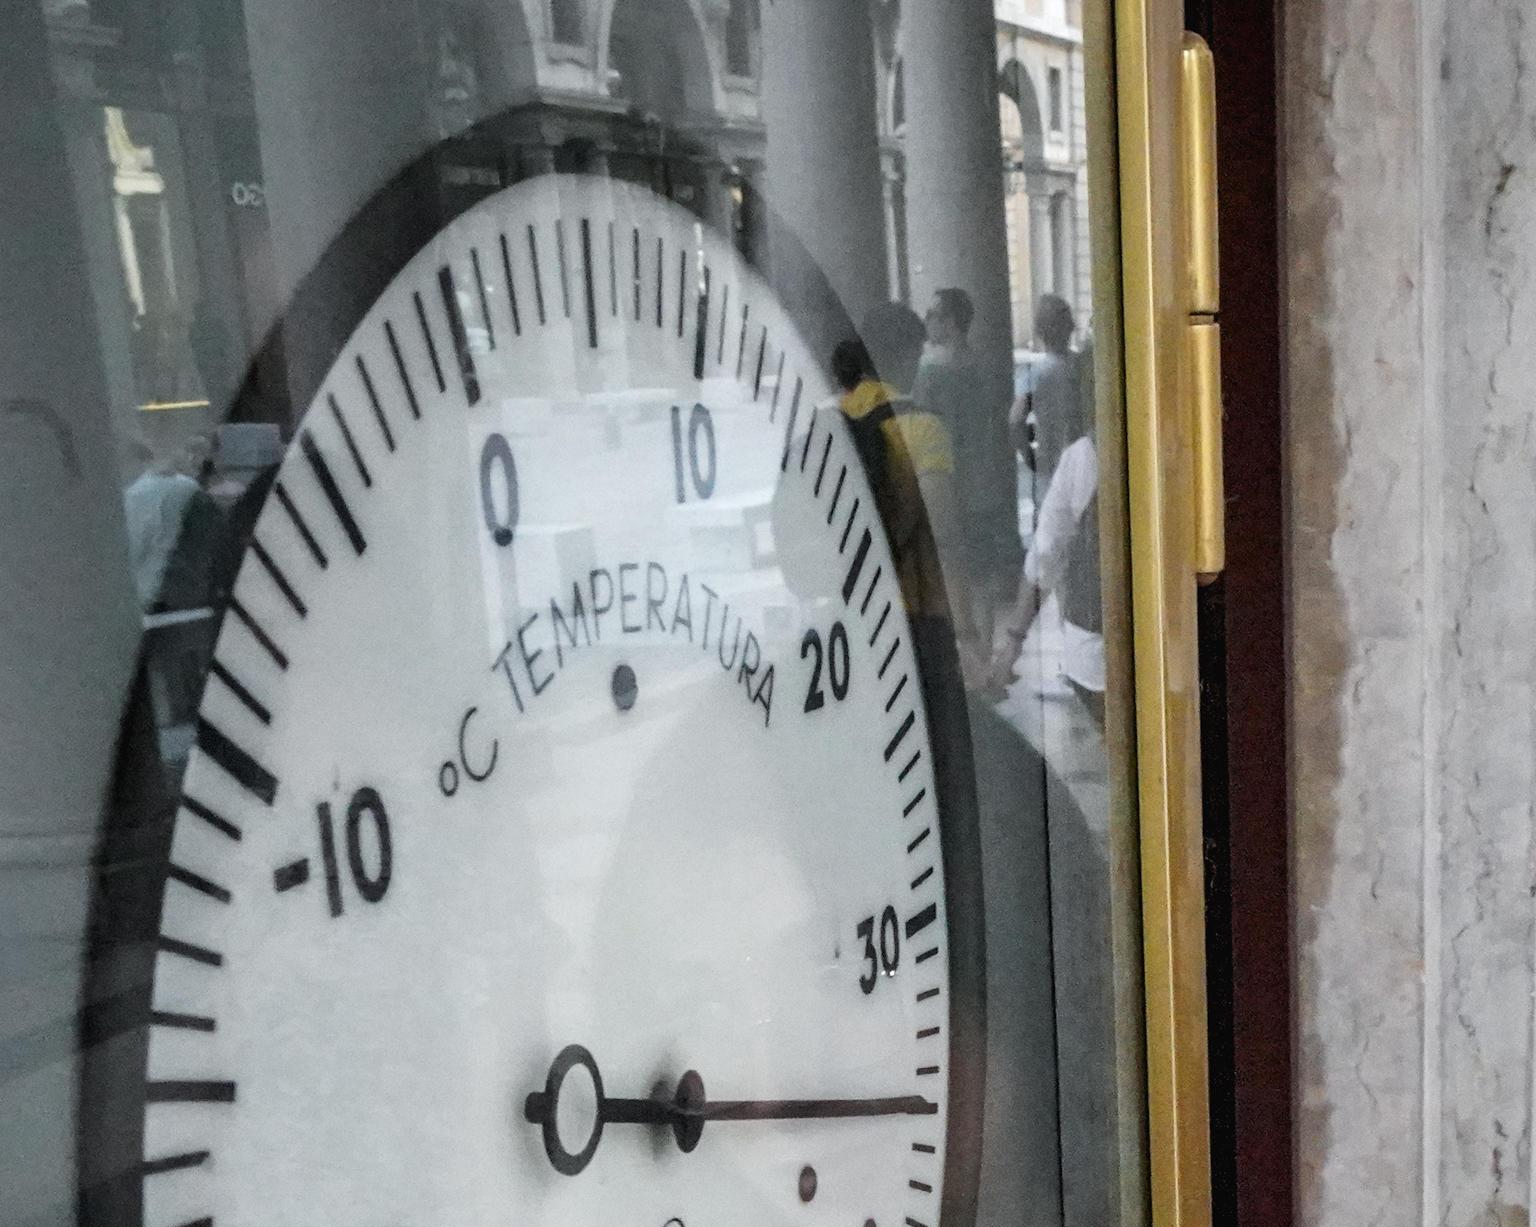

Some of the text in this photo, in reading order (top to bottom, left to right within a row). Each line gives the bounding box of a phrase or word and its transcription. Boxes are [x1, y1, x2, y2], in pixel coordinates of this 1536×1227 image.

[479, 432, 519, 544] 0
[668, 403, 717, 504] 10
[491, 561, 775, 728] TEMPERATURA
[801, 621, 851, 714] 20
[273, 786, 393, 918] -10
[857, 904, 901, 996] 30
